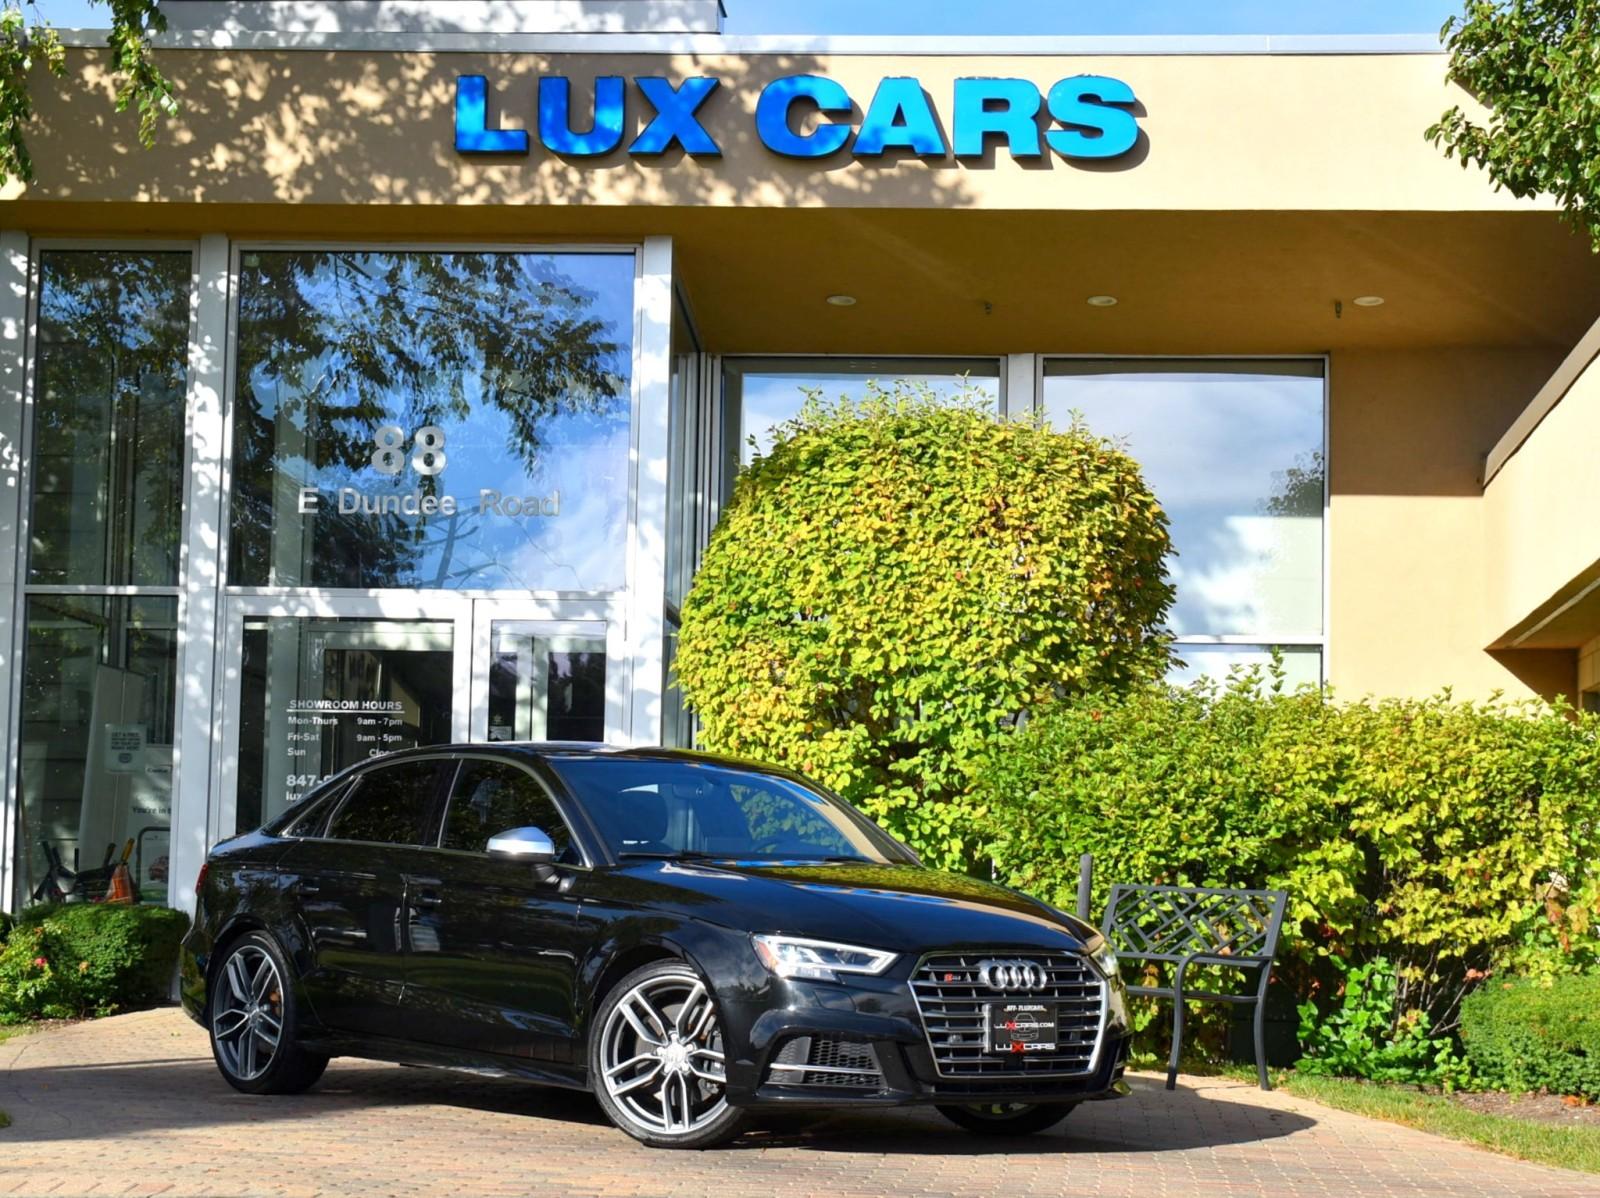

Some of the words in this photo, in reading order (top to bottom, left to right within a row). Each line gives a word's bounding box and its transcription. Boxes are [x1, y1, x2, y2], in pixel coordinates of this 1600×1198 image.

[454, 74, 722, 157] LUX
[754, 73, 1140, 158] CARS
[371, 426, 447, 475] 88
[298, 487, 319, 514] E
[338, 487, 457, 516] Dundee
[479, 488, 561, 516] Road
[289, 699, 359, 710] SHOWROOM
[361, 701, 403, 711] HOURS
[287, 716, 339, 726] Mon-Thurs
[357, 717, 376, 726] 9am
[383, 717, 403, 727] 7pm
[287, 732, 320, 741] Fri-Sat
[356, 733, 376, 742] 9am
[383, 733, 402, 743] 5pm
[287, 747, 306, 757] Sun
